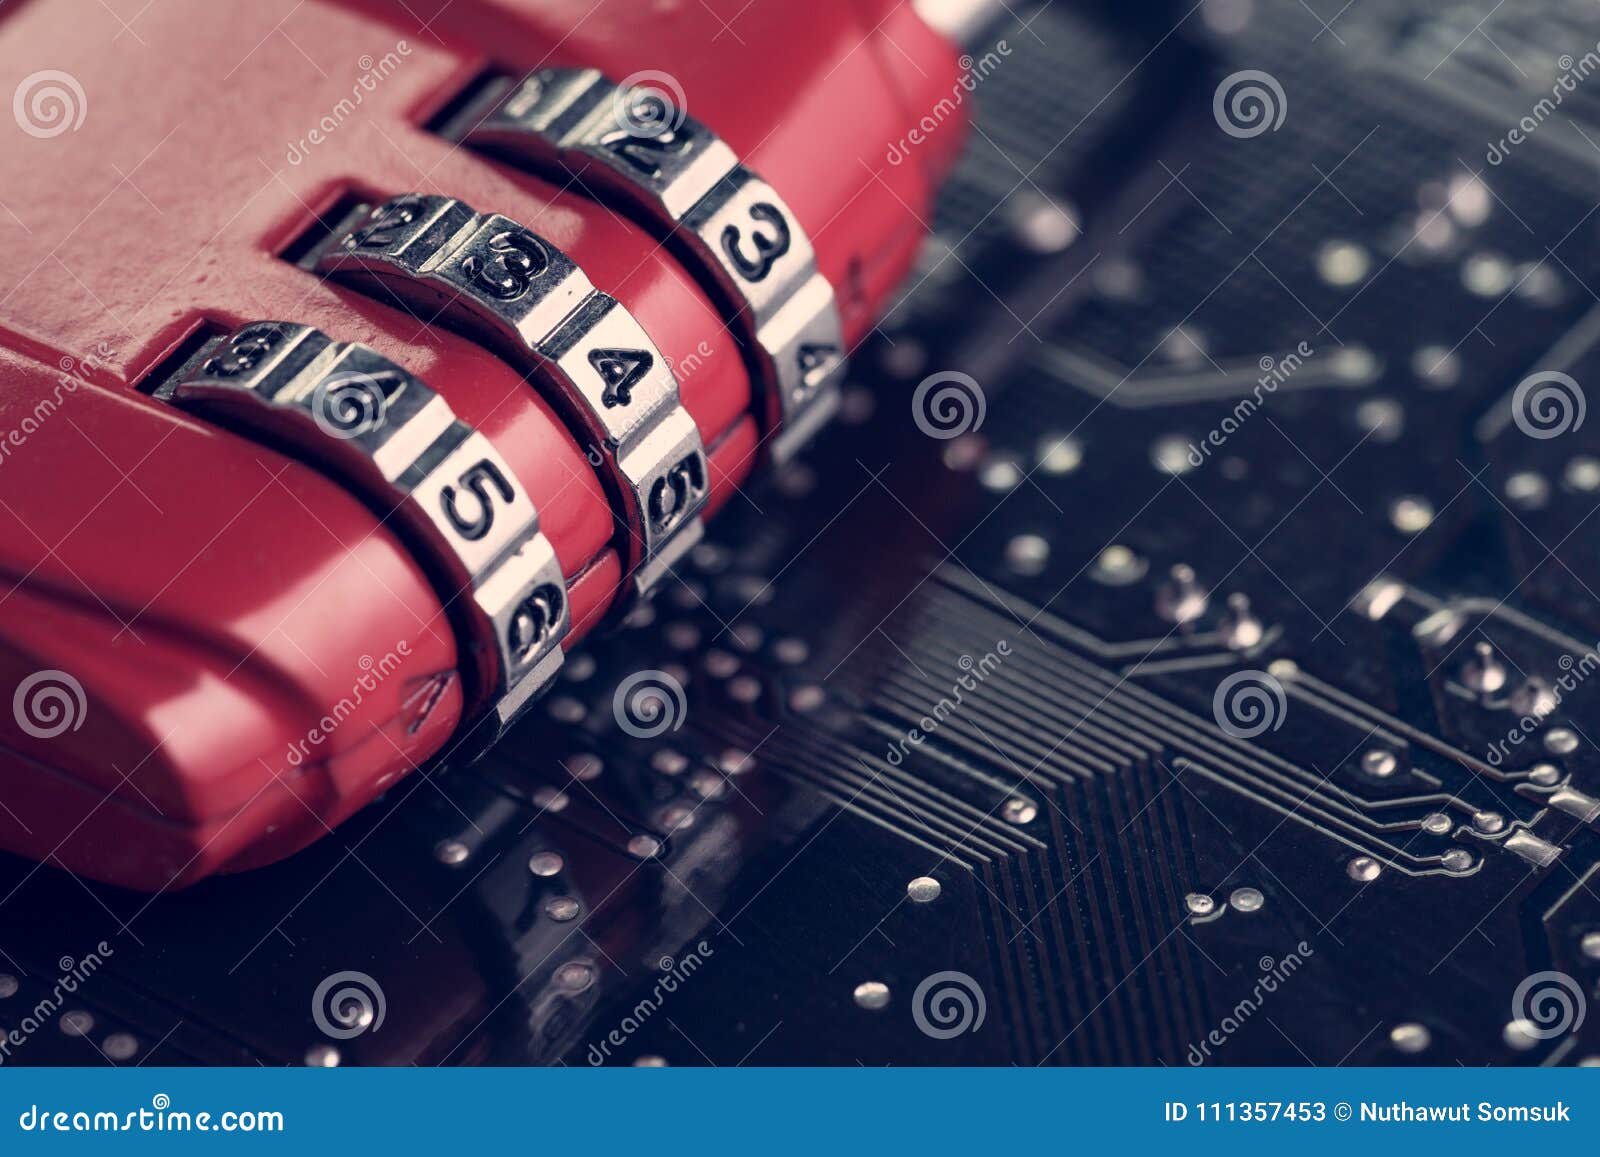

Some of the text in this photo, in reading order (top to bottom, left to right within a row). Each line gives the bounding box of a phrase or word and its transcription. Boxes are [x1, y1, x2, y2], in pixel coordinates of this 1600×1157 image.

[462, 230, 550, 300] 3
[722, 202, 791, 283] 3
[587, 347, 654, 410] 4
[439, 458, 515, 541] 5
[648, 451, 705, 535] 5
[508, 583, 564, 664] 6
